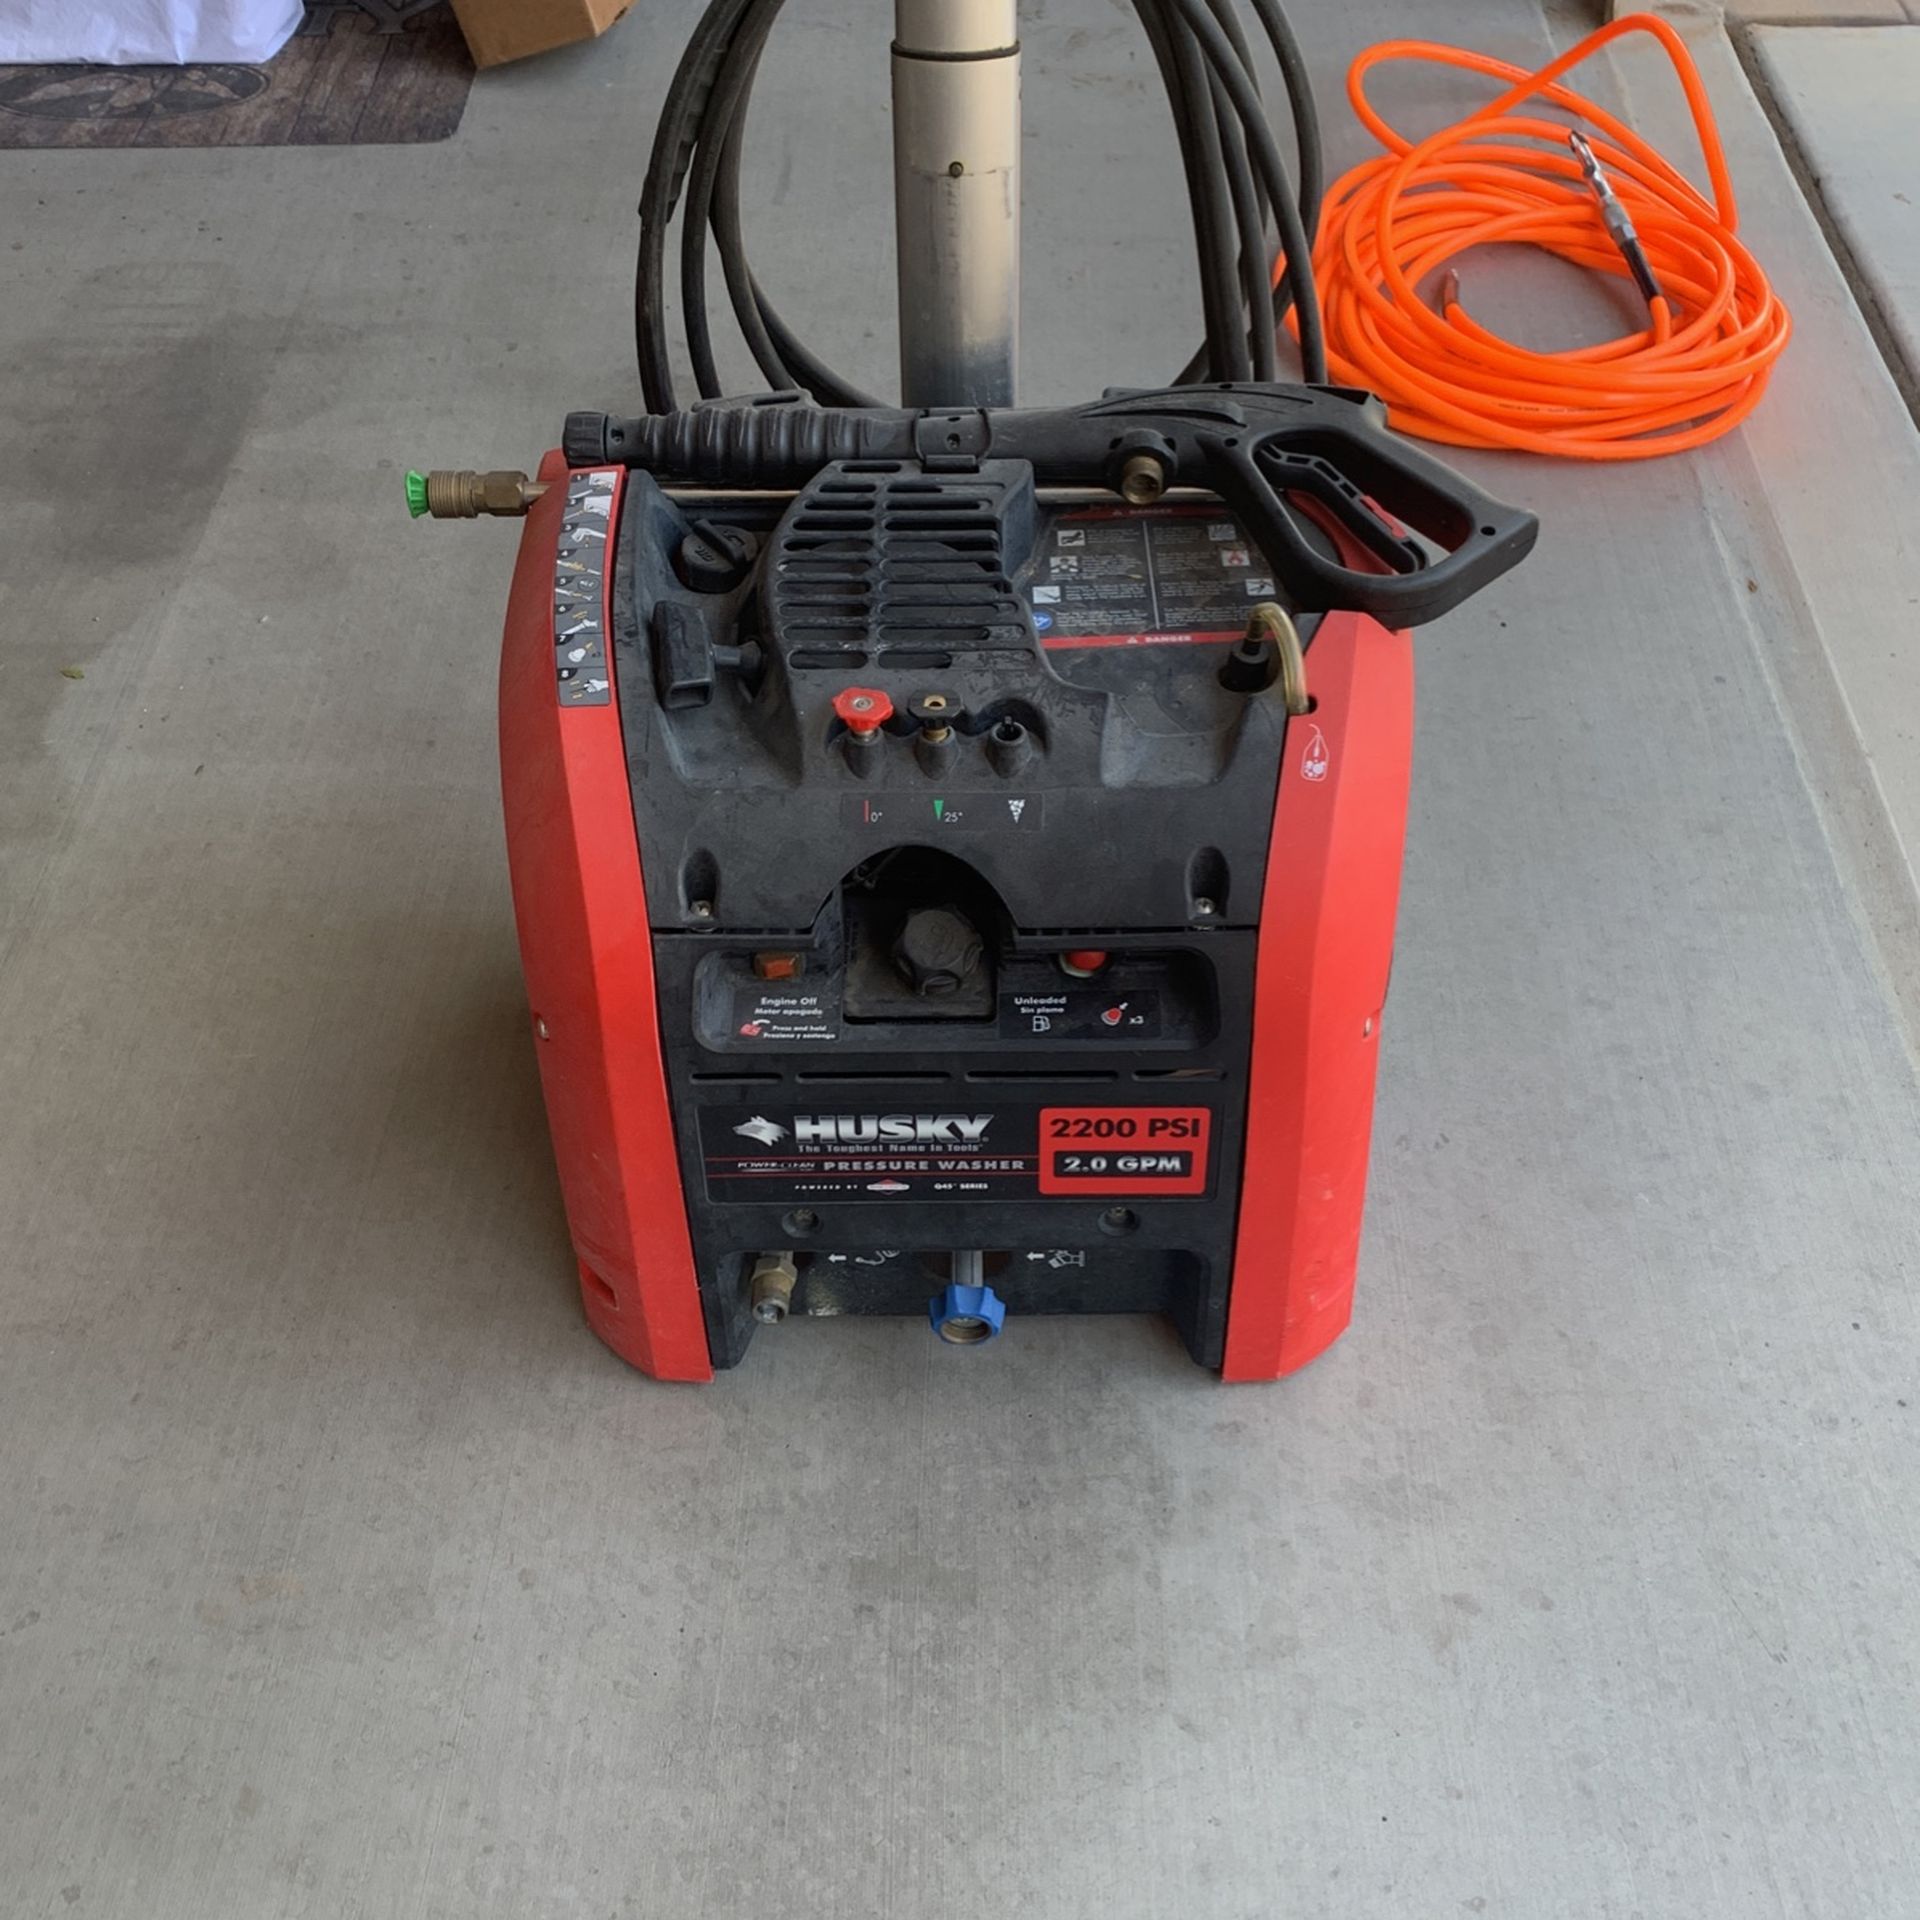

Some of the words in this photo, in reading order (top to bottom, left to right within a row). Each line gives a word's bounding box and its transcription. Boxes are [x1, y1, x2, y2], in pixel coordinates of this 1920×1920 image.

[1144, 635, 1192, 643] DANGER
[760, 996, 798, 1007] Engine
[800, 996, 818, 1005] Off
[1014, 996, 1067, 1005] Unleaded
[794, 1114, 994, 1144] HUSKY
[1050, 1118, 1137, 1138] 2200
[1148, 1118, 1200, 1138] PSI
[798, 1145, 821, 1153] The
[827, 1145, 883, 1153] Toughest
[889, 1144, 925, 1152] Name
[824, 1161, 929, 1170] PRESSURE
[938, 1160, 1025, 1170] WASHER
[1063, 1156, 1107, 1172] 2.0
[1116, 1156, 1182, 1172] GPM
